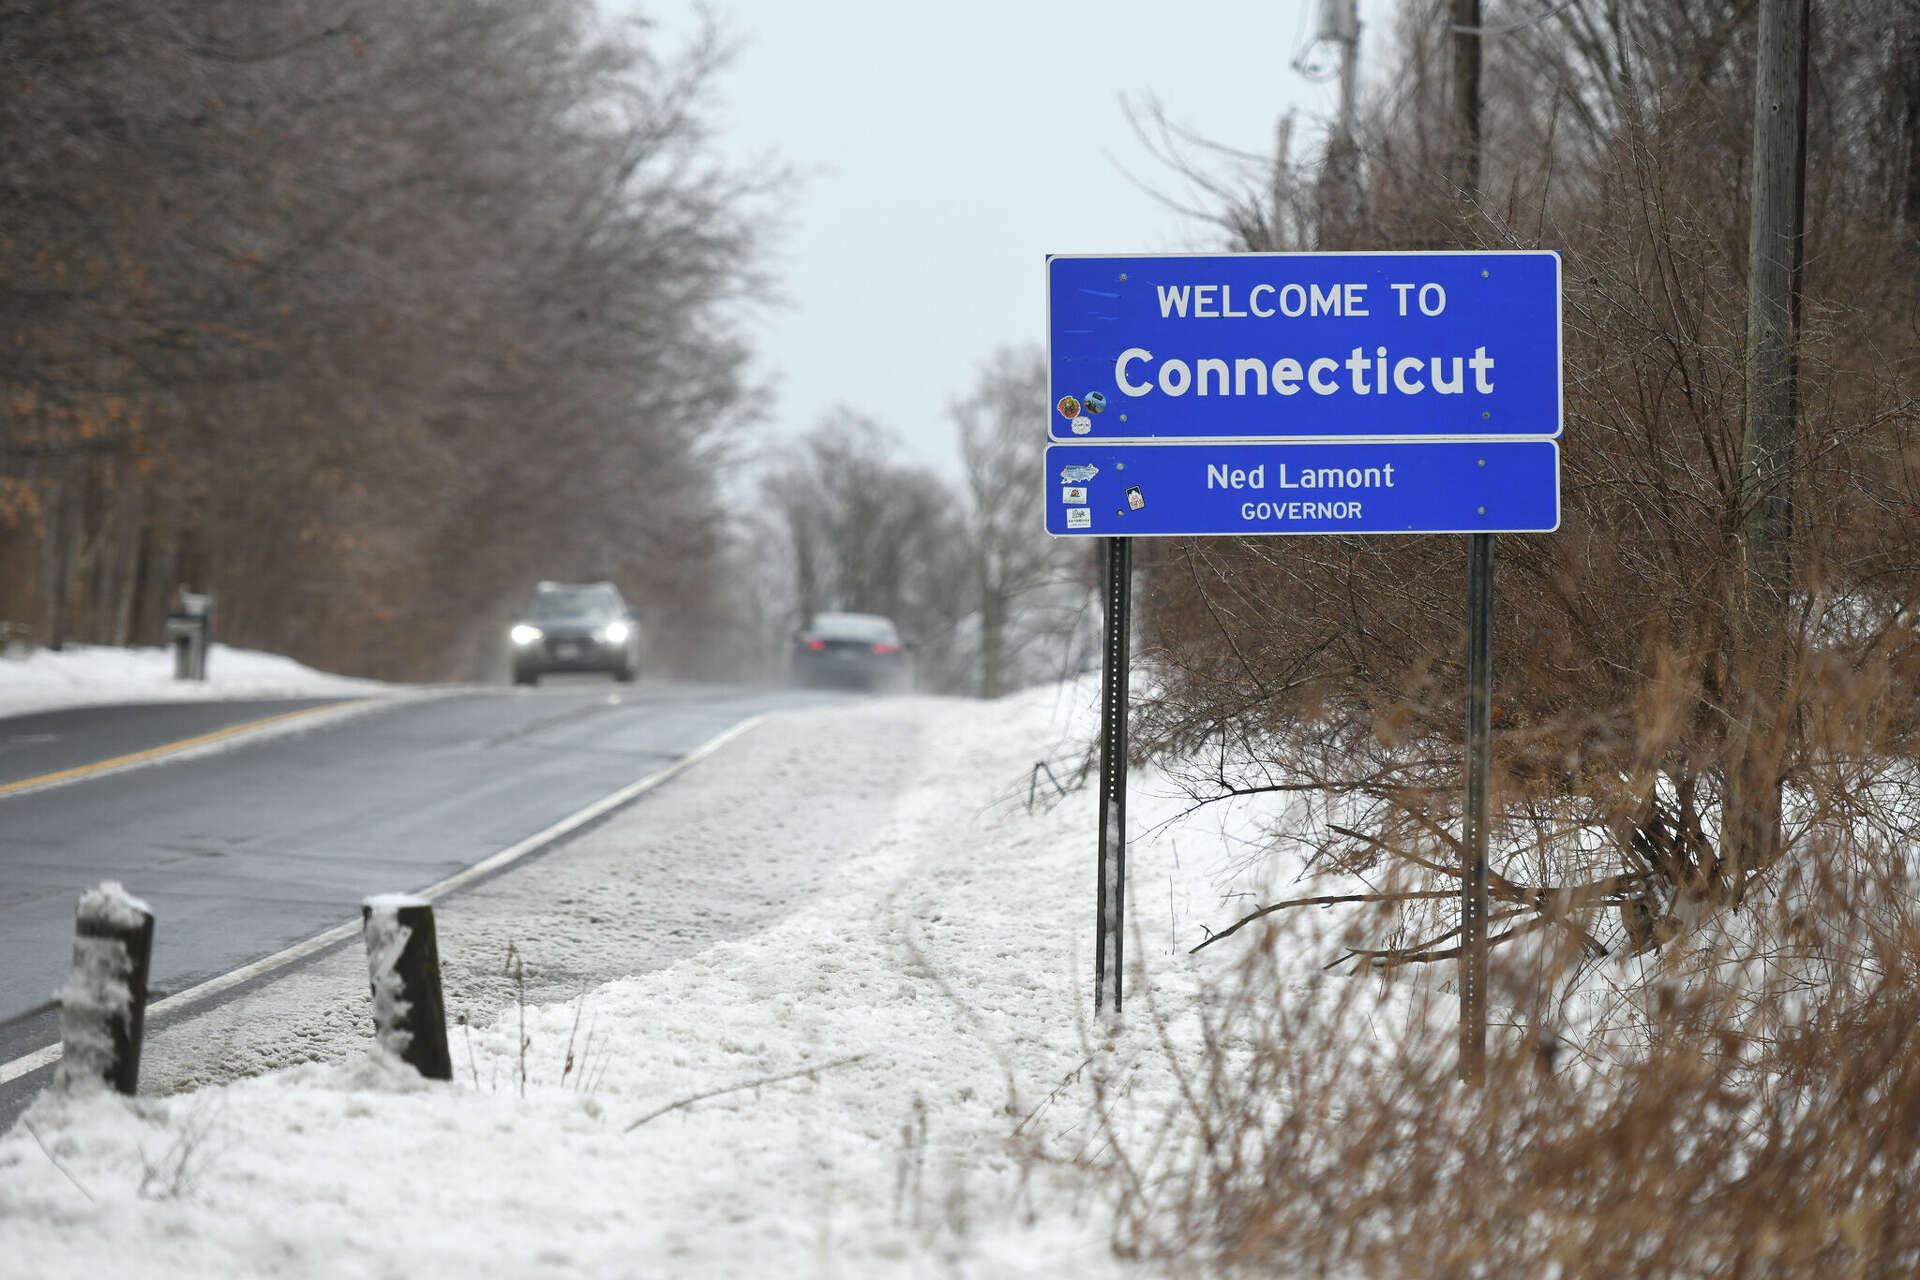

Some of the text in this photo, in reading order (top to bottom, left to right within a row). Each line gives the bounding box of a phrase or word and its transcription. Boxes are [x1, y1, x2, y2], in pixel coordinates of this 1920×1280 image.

[1157, 283, 1446, 318] WELCOME TO
[1115, 347, 1495, 397] Connecticut
[1207, 463, 1395, 490] Ned Lamont
[1241, 502, 1362, 521] GOVERNOR
